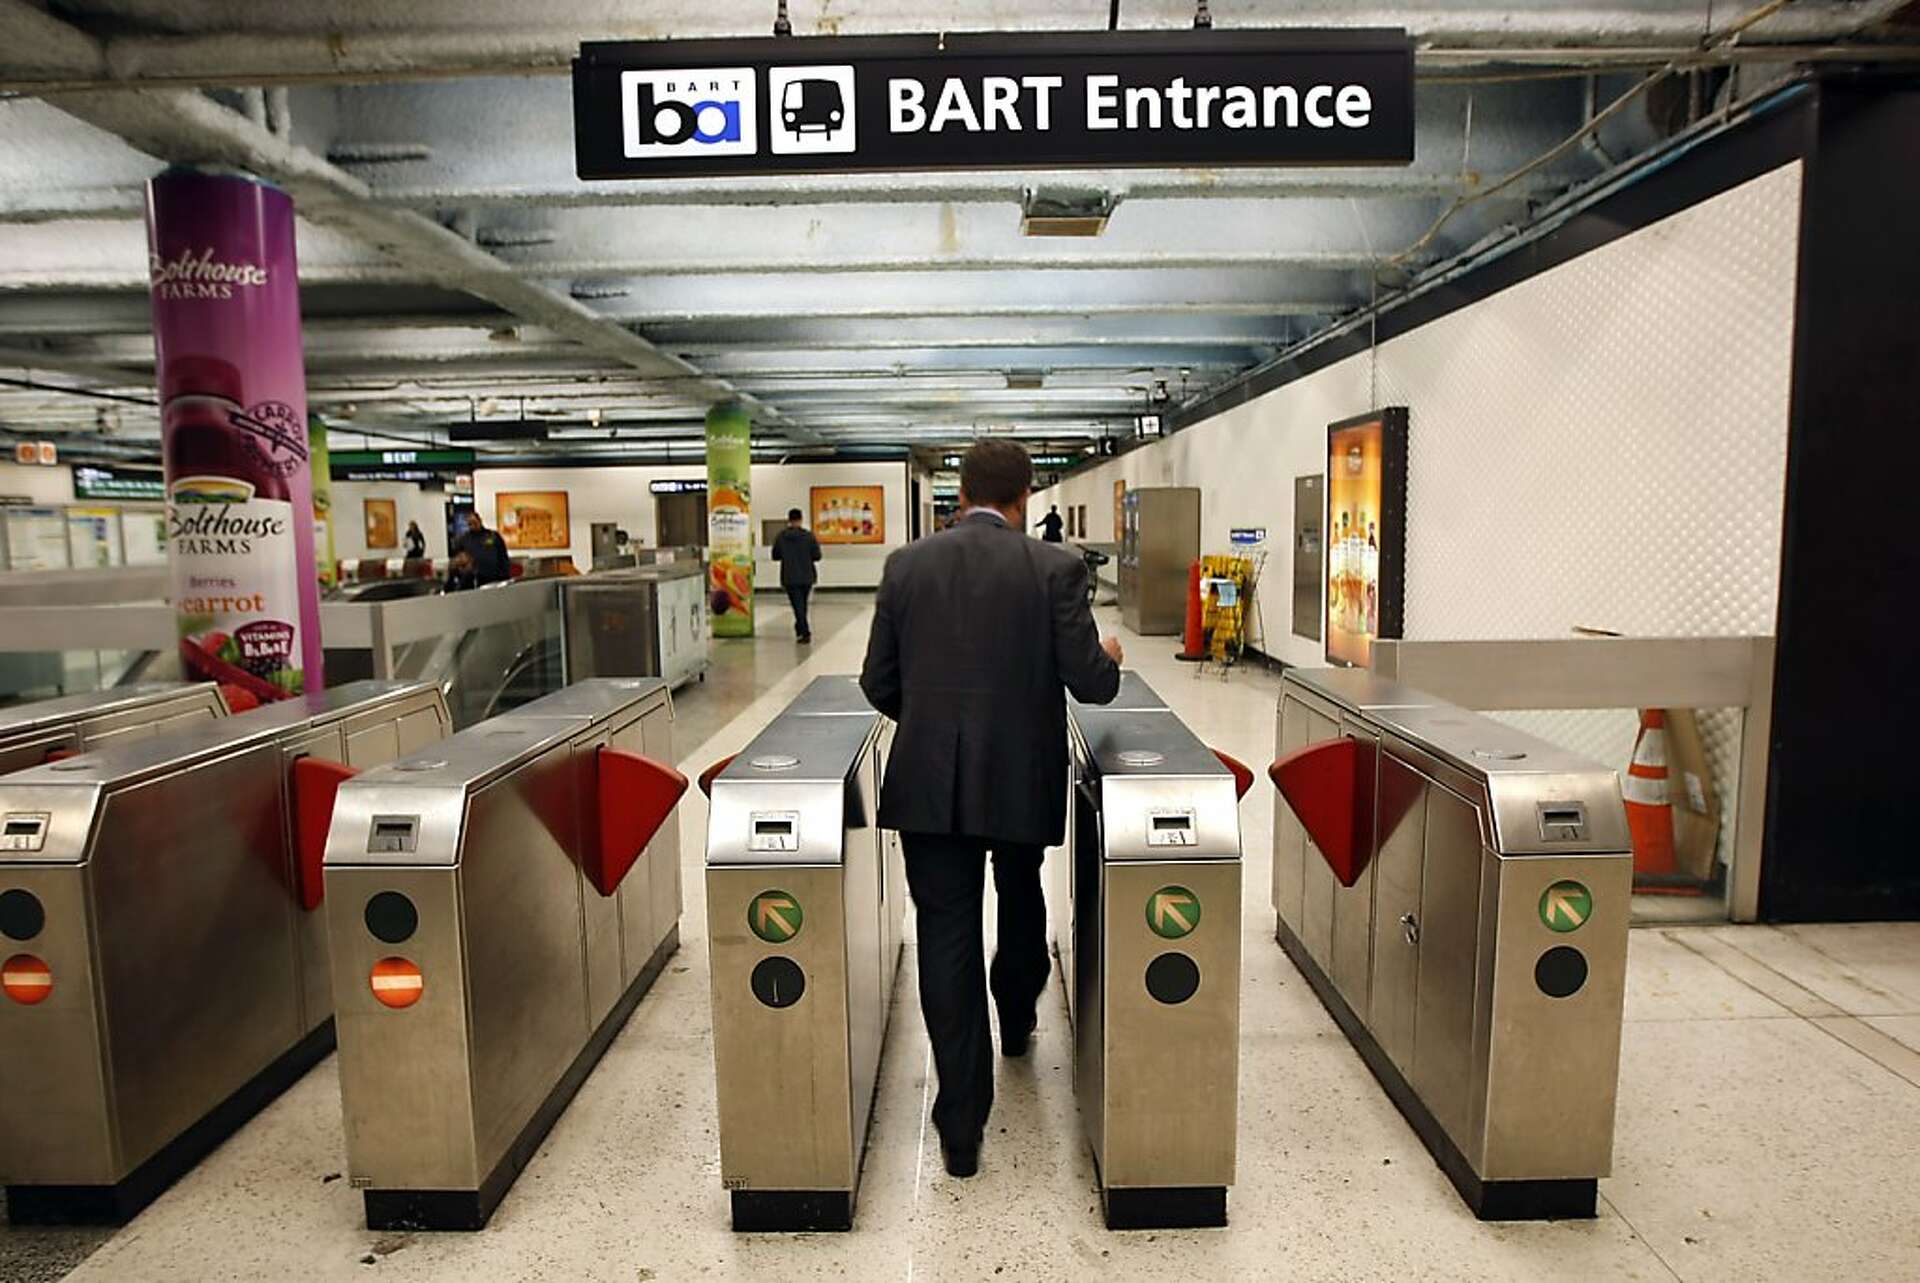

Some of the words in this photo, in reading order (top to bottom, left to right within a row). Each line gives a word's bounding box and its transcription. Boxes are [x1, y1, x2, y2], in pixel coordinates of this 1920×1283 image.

[667, 80, 741, 93] BART
[888, 76, 1062, 133] BART
[1086, 75, 1372, 130] Entrance
[179, 539, 251, 554] FARMS
